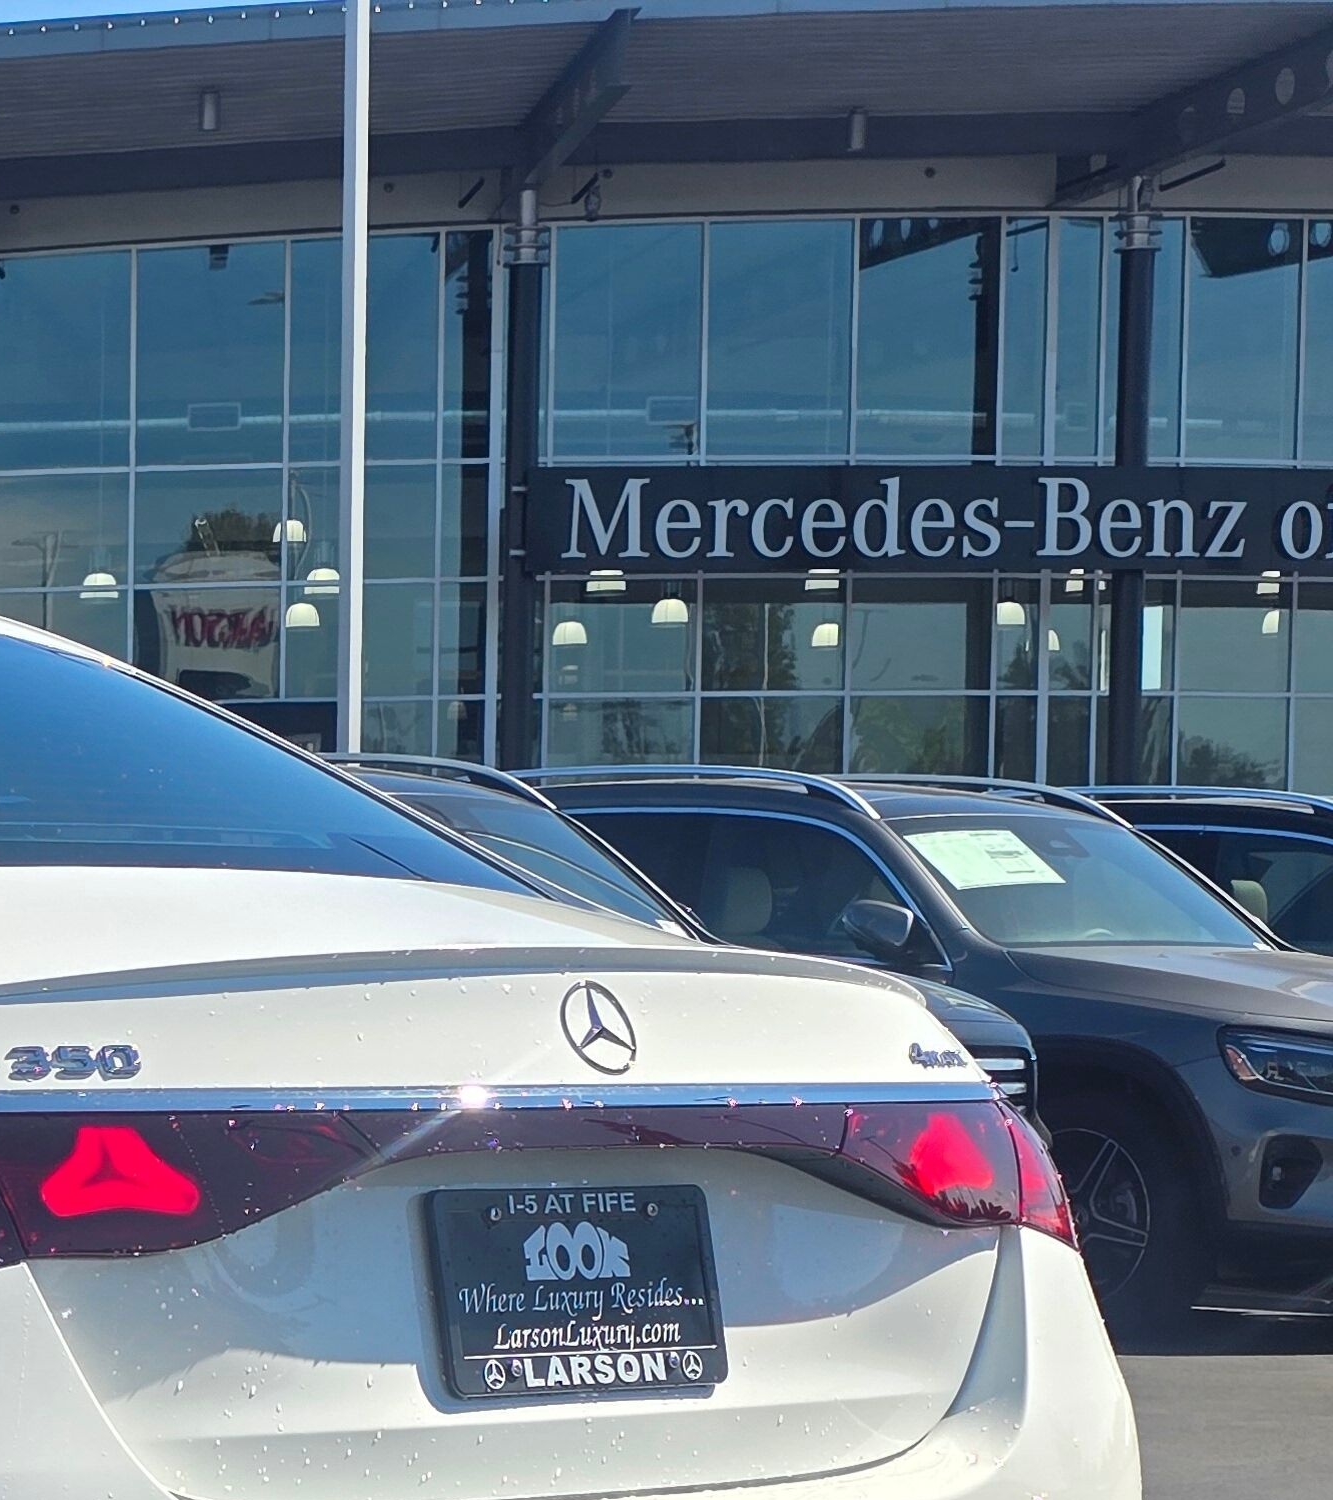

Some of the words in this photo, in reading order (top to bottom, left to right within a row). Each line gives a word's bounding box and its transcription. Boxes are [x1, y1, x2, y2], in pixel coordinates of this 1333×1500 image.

[560, 476, 1247, 560] Mercedes-Benz
[1280, 500, 1333, 560] o
[4, 1044, 143, 1083] 350
[508, 1194, 539, 1215] I-5
[544, 1193, 574, 1214] AT
[582, 1192, 637, 1213] FIFE
[458, 1283, 525, 1314] Where
[533, 1285, 604, 1321] Luxury
[493, 1320, 682, 1352] LarsonLuxury.com
[522, 1351, 668, 1388] LARSON
